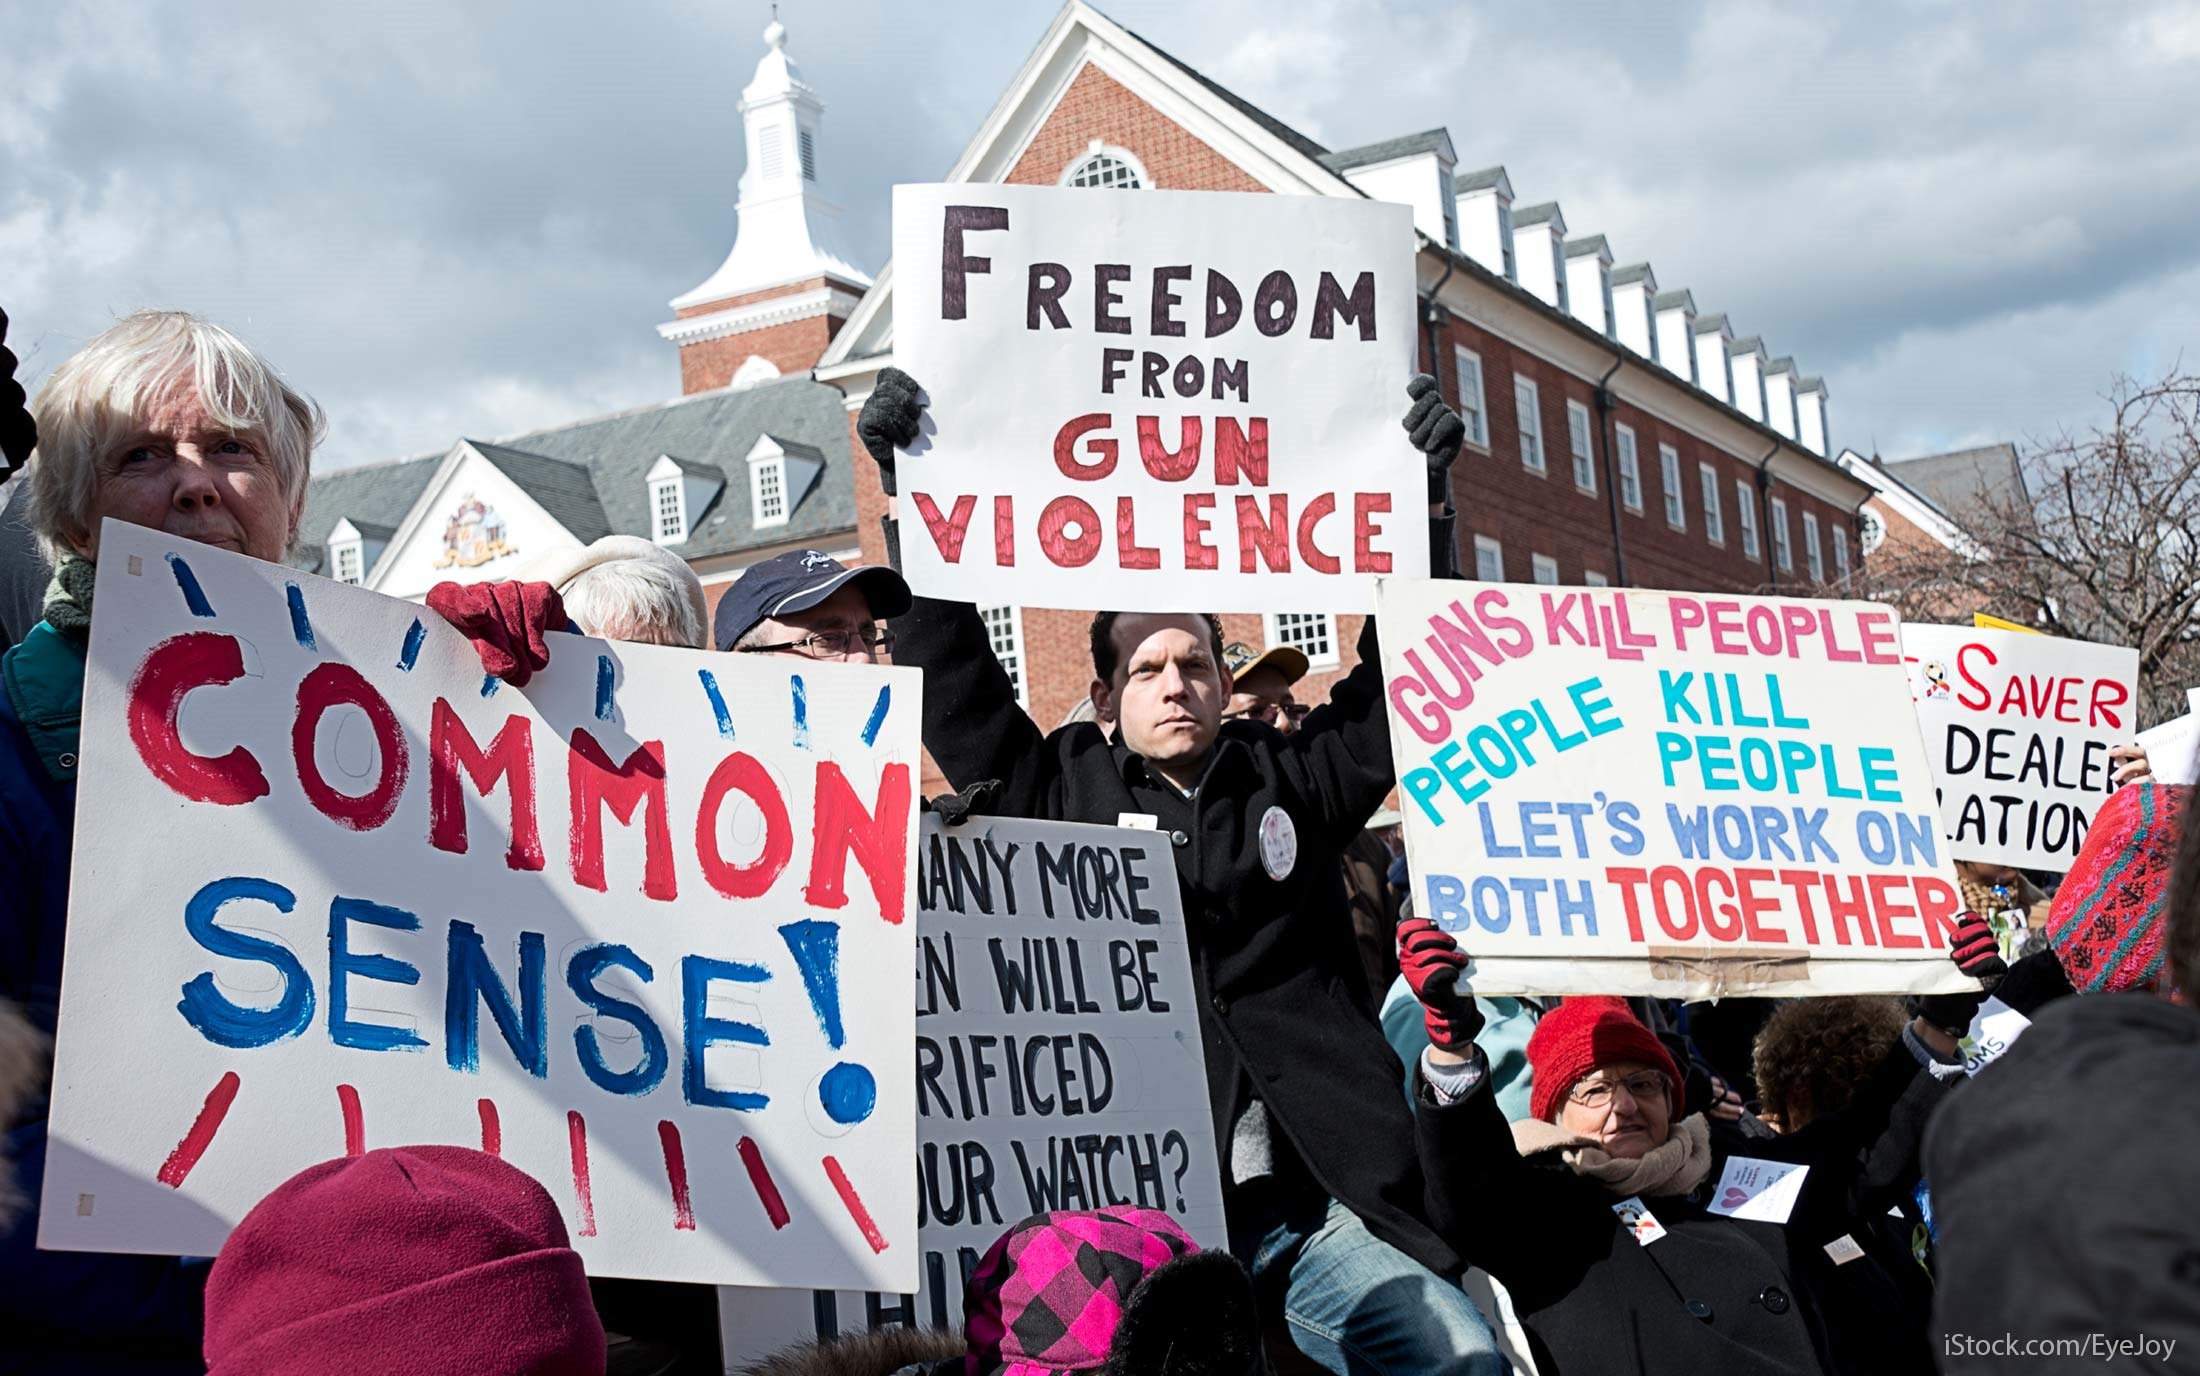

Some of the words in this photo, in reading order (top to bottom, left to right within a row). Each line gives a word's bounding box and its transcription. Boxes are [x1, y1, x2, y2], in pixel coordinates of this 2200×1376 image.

[941, 205, 1377, 342] FREEDOM
[1102, 348, 1249, 403] FROM
[1053, 413, 1269, 487] GUN
[911, 492, 1393, 575] VIOLENCE
[1387, 589, 1534, 744] GUNS
[1540, 592, 1657, 662] KILL
[1668, 597, 1900, 665] PEOPLE
[1957, 643, 2129, 730] SAVER
[127, 630, 911, 925] COMMON
[1400, 676, 1624, 827] PEOPLE
[1658, 669, 1810, 729] KILL
[1656, 731, 1903, 803] PEOPLE
[1477, 790, 1645, 859] LET'S
[1666, 802, 1840, 864] WORK
[1856, 810, 1938, 868] ON
[1036, 841, 1161, 925] MORE
[1425, 874, 1600, 937] BOTH
[1606, 865, 1960, 949] TOGETHER
[178, 876, 877, 1124] SENSE!
[988, 936, 1100, 1015] WILL
[1109, 938, 1170, 1015] BE
[918, 1140, 1004, 1227] UR
[1011, 1129, 1189, 1215] WATCH?
